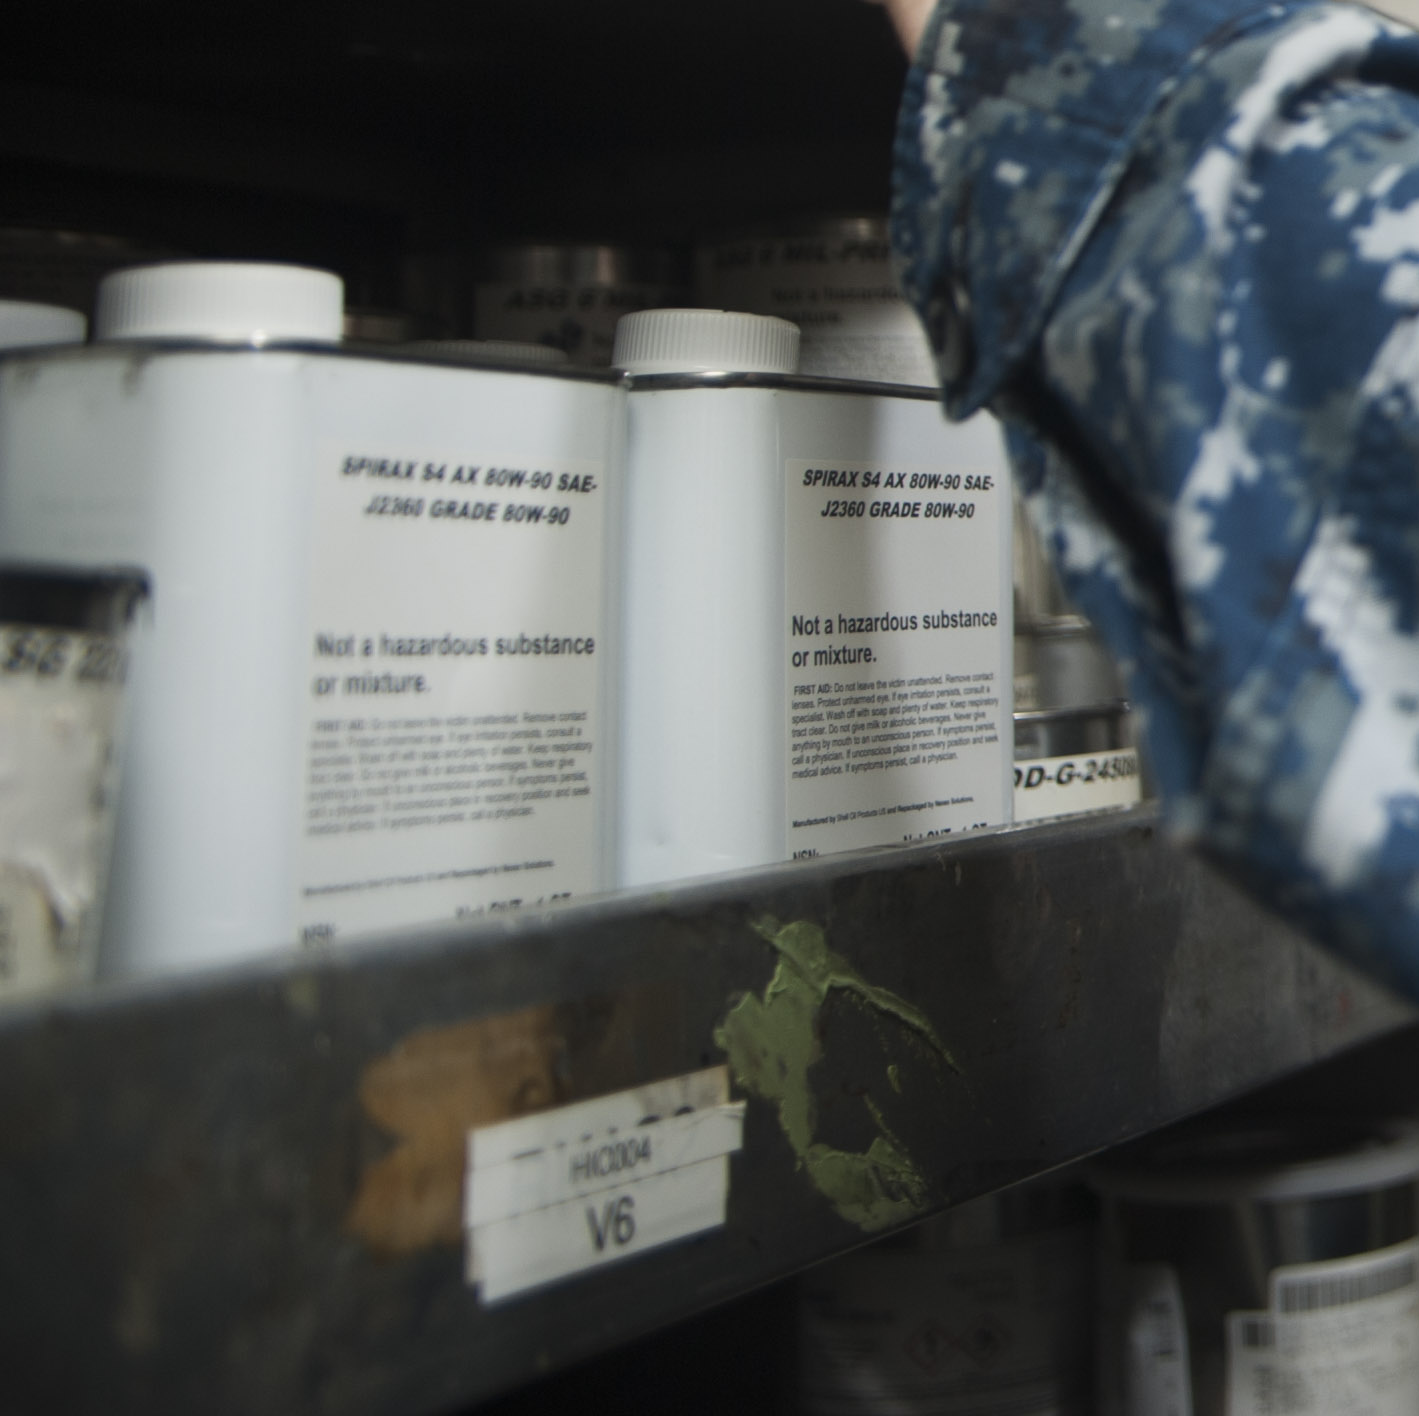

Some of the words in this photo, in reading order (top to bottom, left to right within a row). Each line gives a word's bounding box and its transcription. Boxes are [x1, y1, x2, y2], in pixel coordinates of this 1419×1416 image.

[342, 456, 418, 480] SPIRAX
[422, 462, 446, 482] S4
[451, 465, 481, 484] AX
[484, 467, 553, 489] 80W-90
[556, 473, 598, 493] SAE-
[802, 469, 859, 487] SPIRAX
[862, 471, 881, 488] S4
[883, 472, 907, 489] AX
[909, 473, 961, 490] 80W-90
[963, 475, 994, 491] SAE-
[364, 495, 425, 517] J2360
[430, 499, 498, 521] GRADE
[502, 503, 570, 525] 80W-90
[821, 500, 866, 517] J2360
[869, 501, 922, 518] GRADE
[924, 502, 975, 519] 80W-90
[792, 615, 820, 636] Not
[824, 619, 833, 634] a
[838, 612, 918, 634] hazardous
[922, 610, 998, 630] substance
[315, 634, 355, 657] Not
[362, 639, 373, 656] a
[380, 634, 488, 656] hazardous
[495, 634, 595, 655] substance
[791, 650, 809, 667] or
[814, 644, 877, 666] mixture.
[585, 1195, 636, 1252] V6
